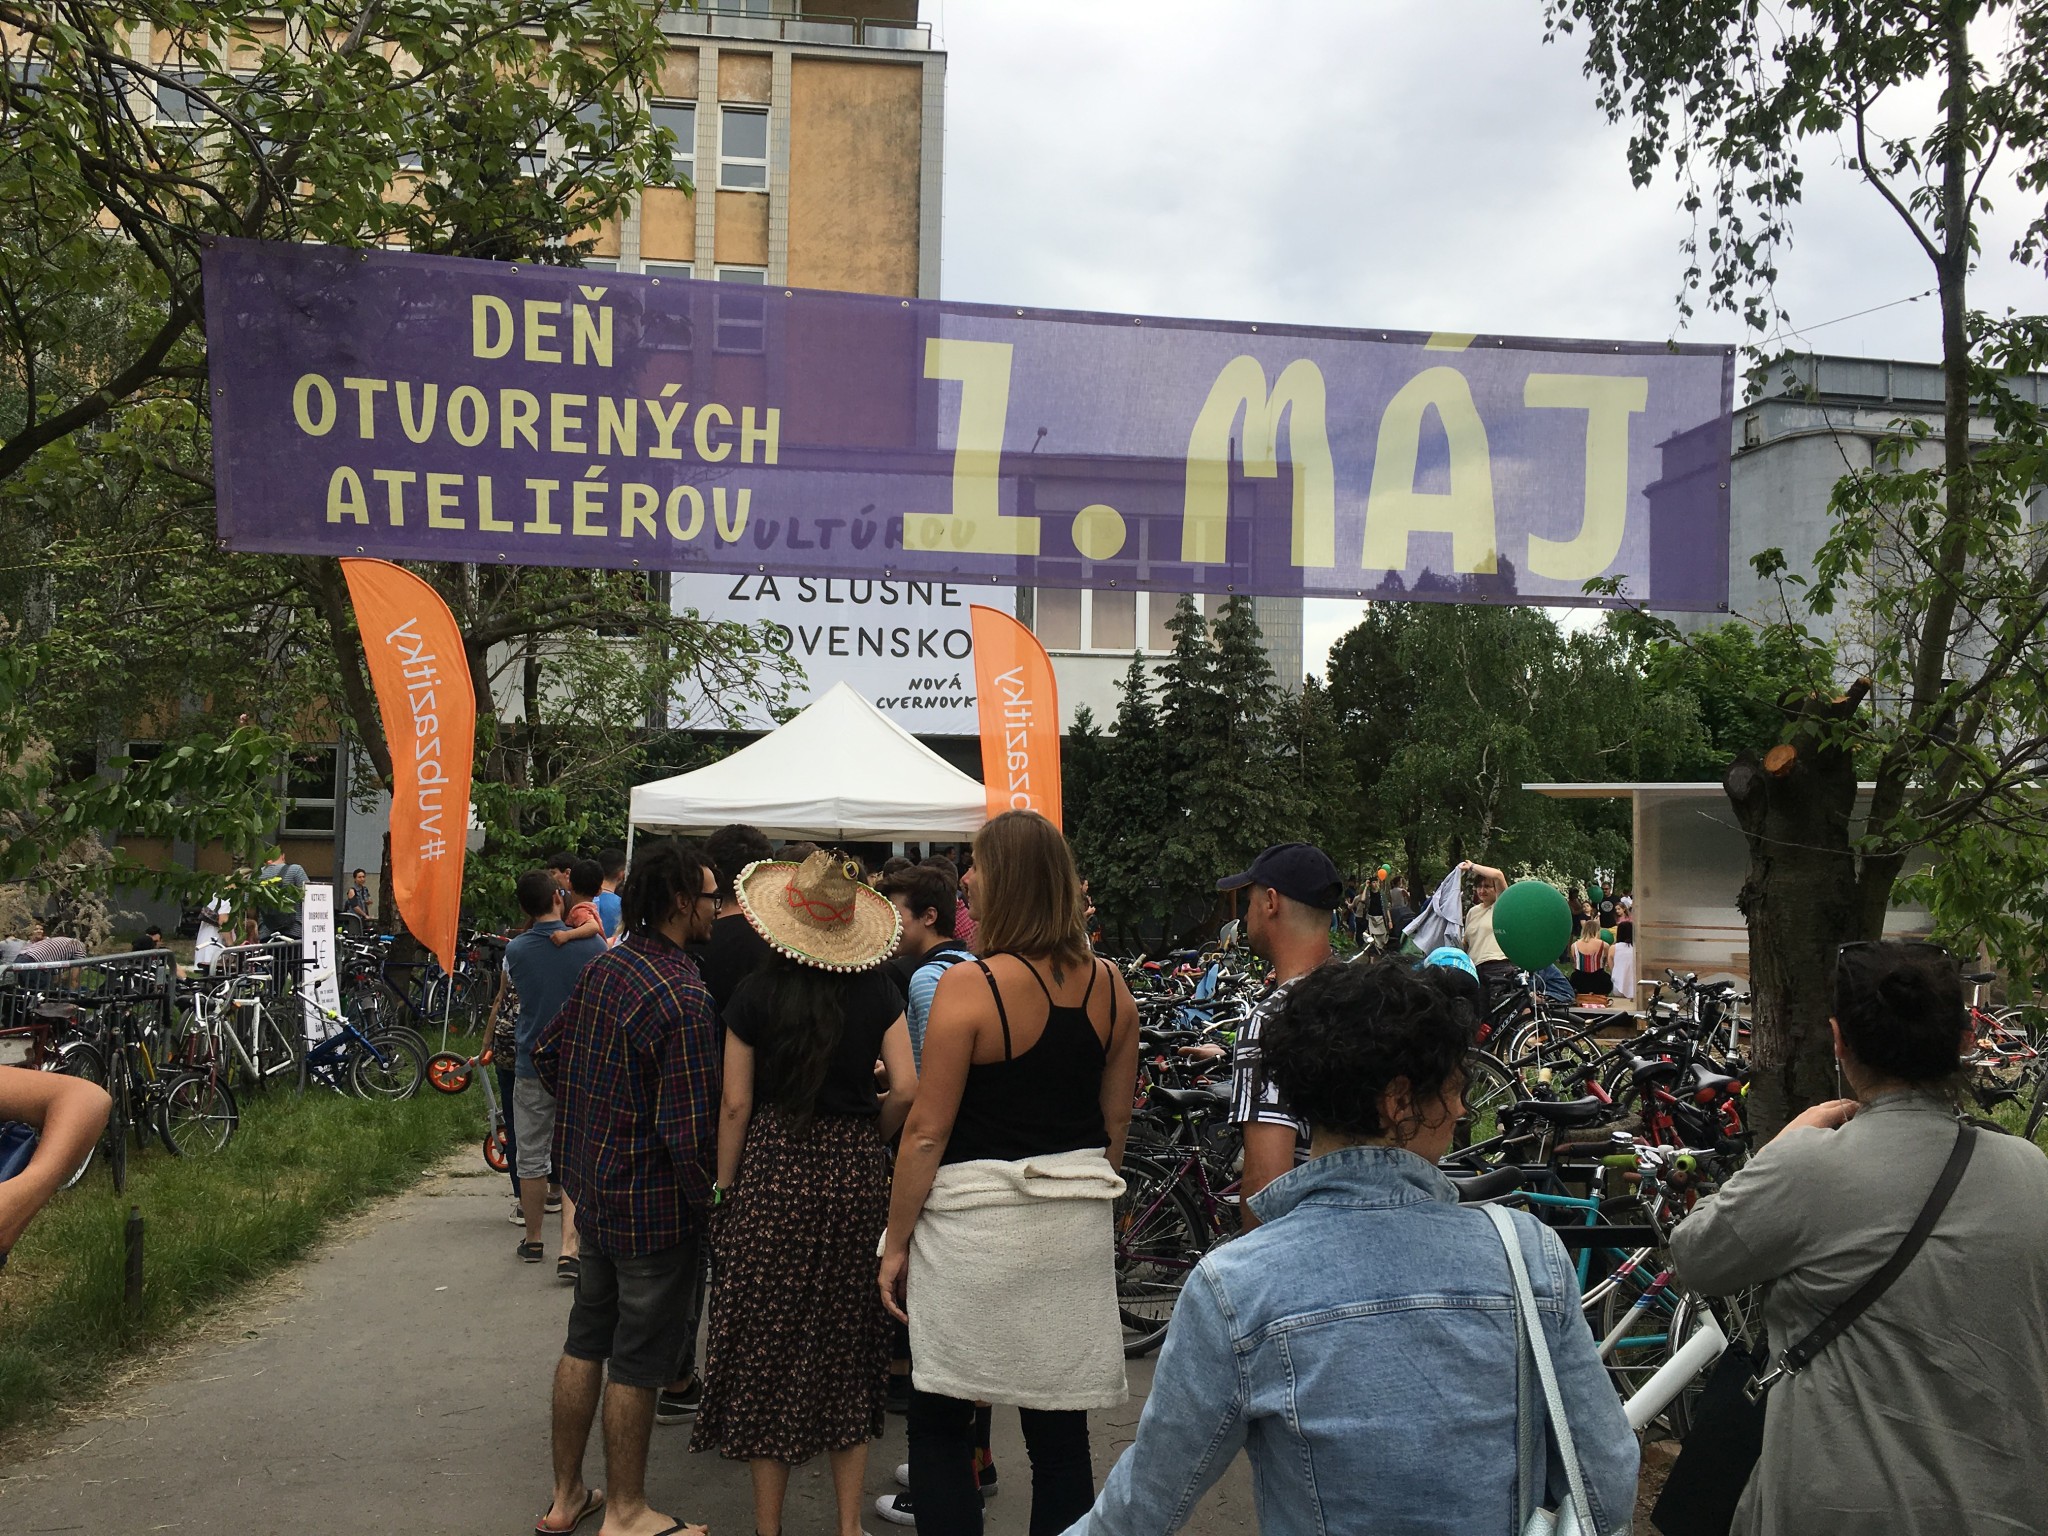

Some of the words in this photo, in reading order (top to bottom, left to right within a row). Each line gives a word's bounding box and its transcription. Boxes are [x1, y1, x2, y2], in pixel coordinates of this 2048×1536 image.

[472, 285, 613, 368] DEŇ
[292, 372, 782, 465] OTVORENÝCH
[902, 338, 1127, 561] 1.
[1180, 331, 1649, 582] MÁJ
[325, 464, 752, 544] ATELIÉROV
[875, 695, 977, 710] CVERNOVK
[908, 672, 962, 691] NOVÁ
